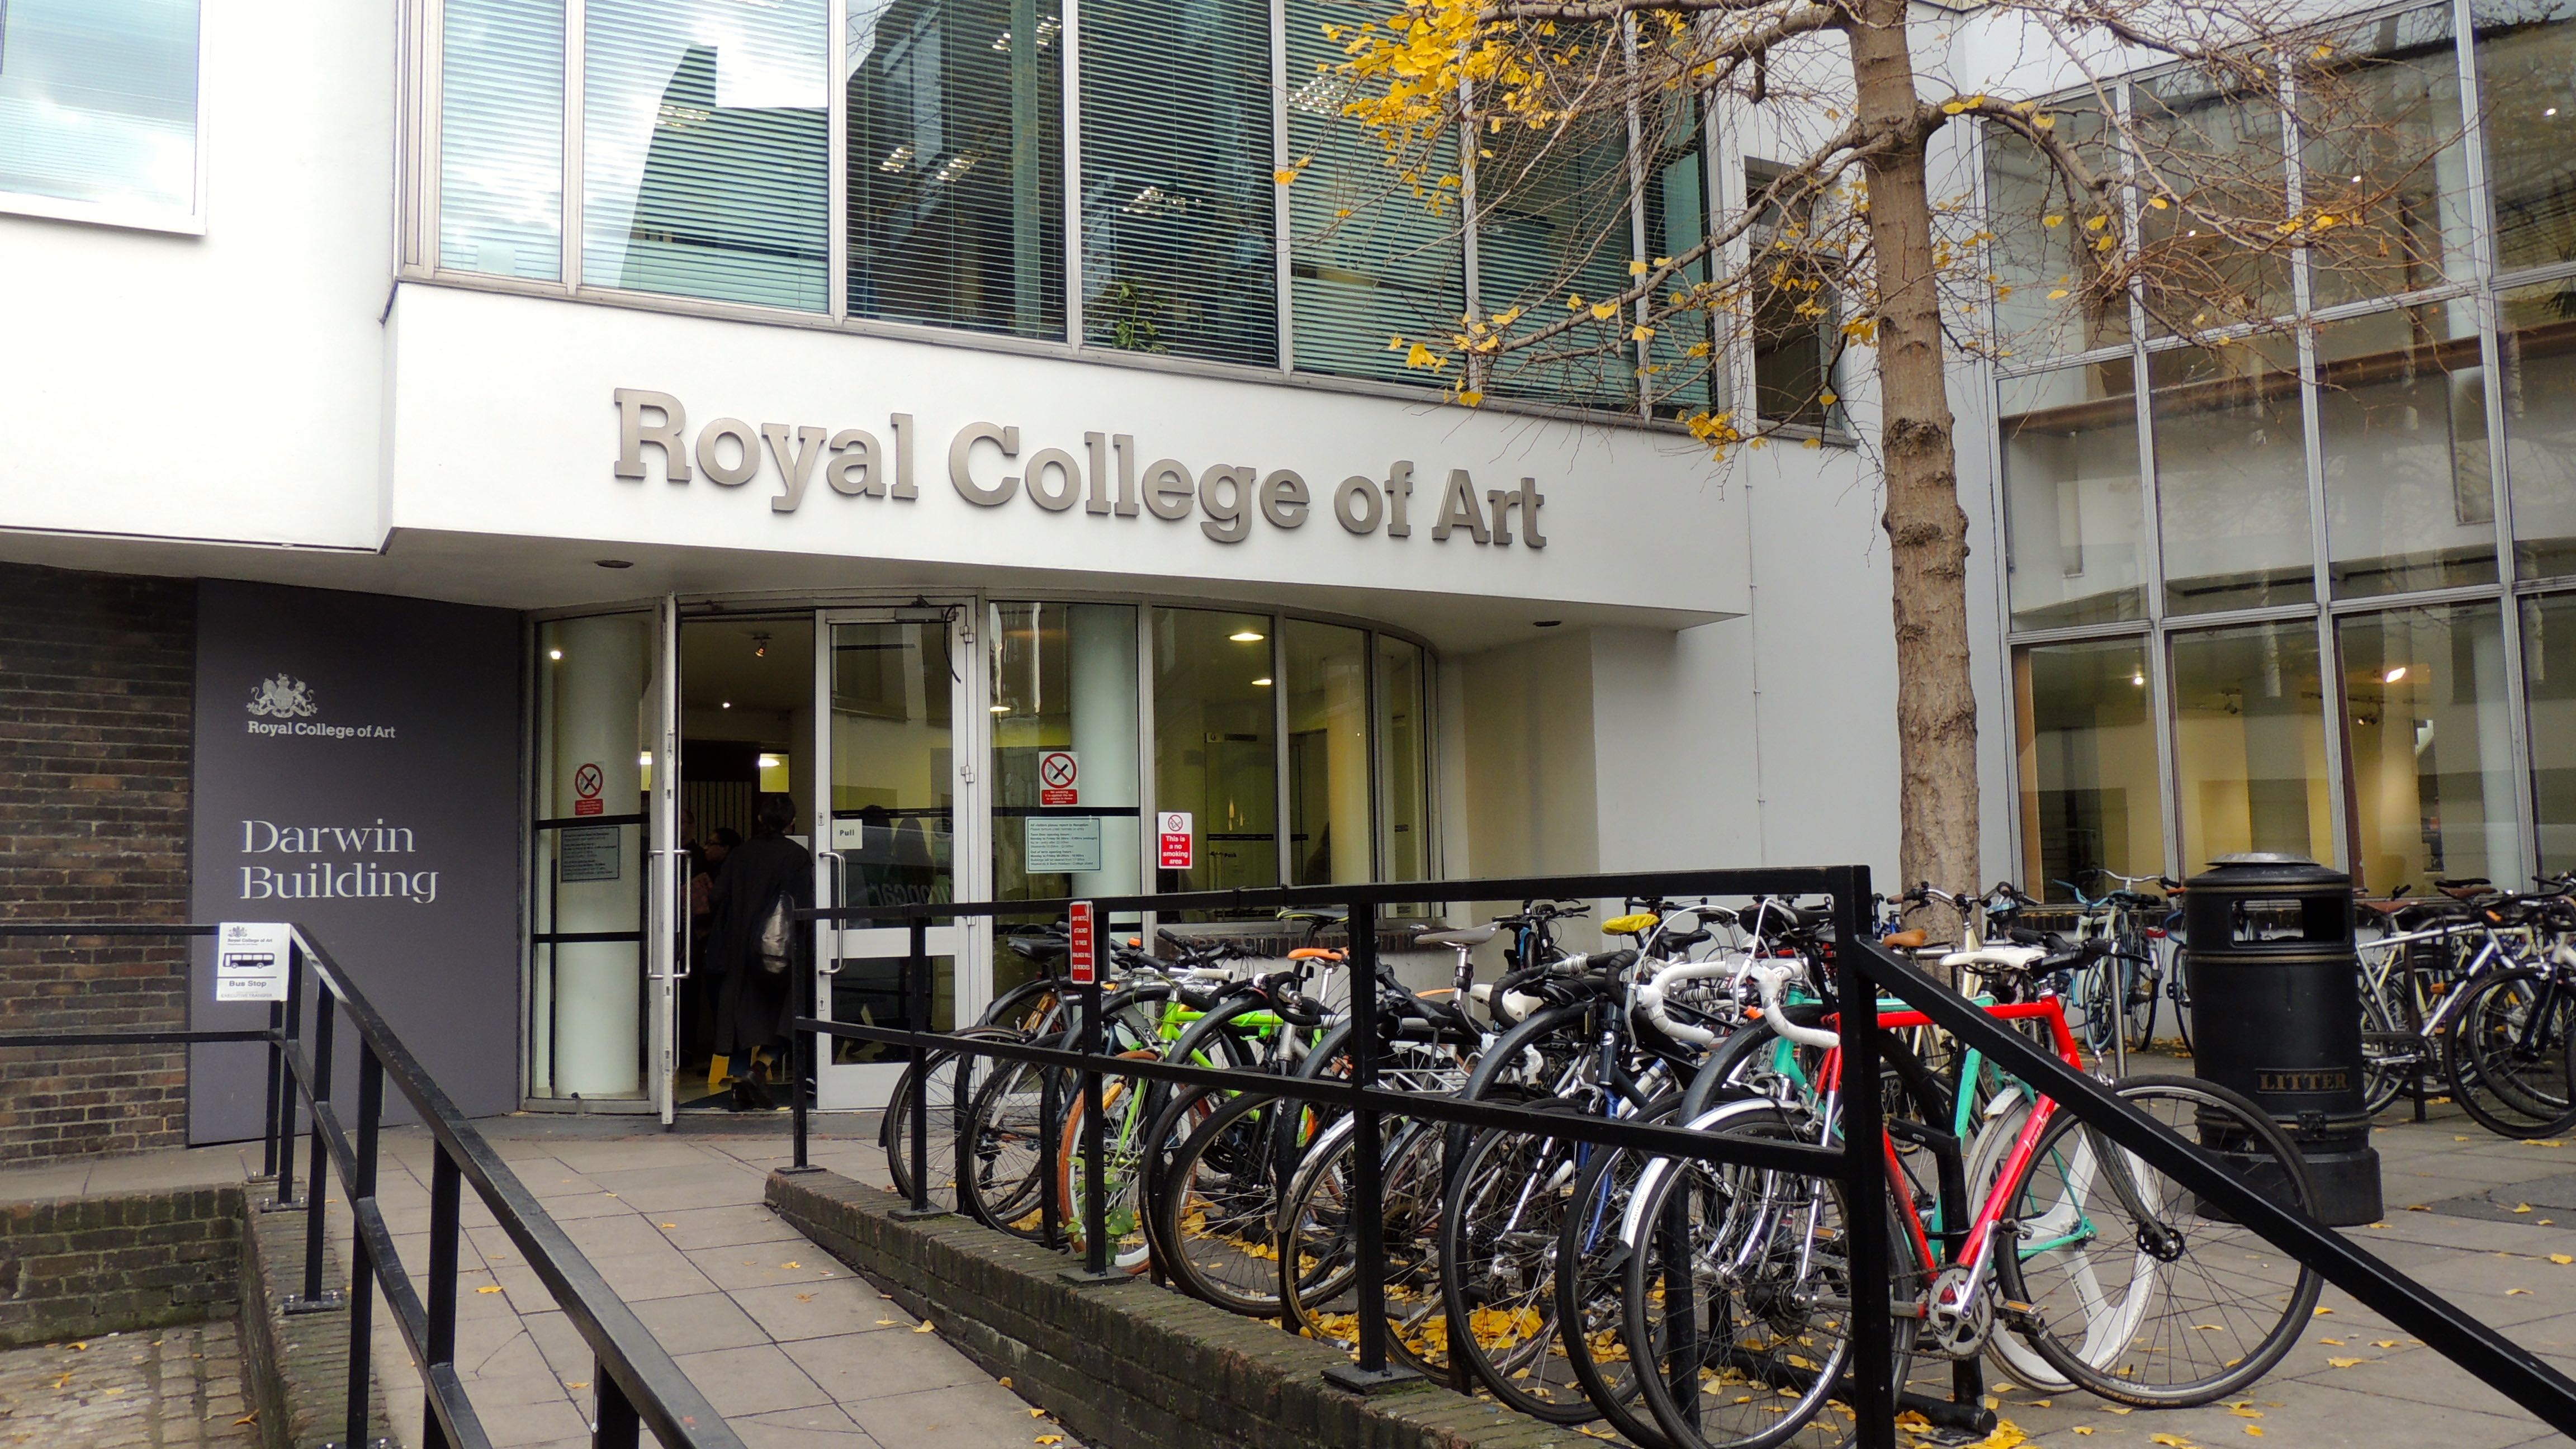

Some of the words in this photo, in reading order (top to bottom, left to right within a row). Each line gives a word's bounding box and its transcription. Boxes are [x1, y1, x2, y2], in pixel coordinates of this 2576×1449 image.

[614, 387, 918, 513] Royal
[949, 421, 1310, 543] College
[1334, 460, 1414, 538] of
[1432, 468, 1547, 549] Art
[248, 721, 292, 737] Royal
[295, 722, 354, 739] College
[357, 724, 372, 737] of
[373, 726, 396, 738] Art
[242, 818, 416, 853] Darwin
[240, 863, 439, 903] Building
[2259, 1072, 2348, 1090] LITTER
